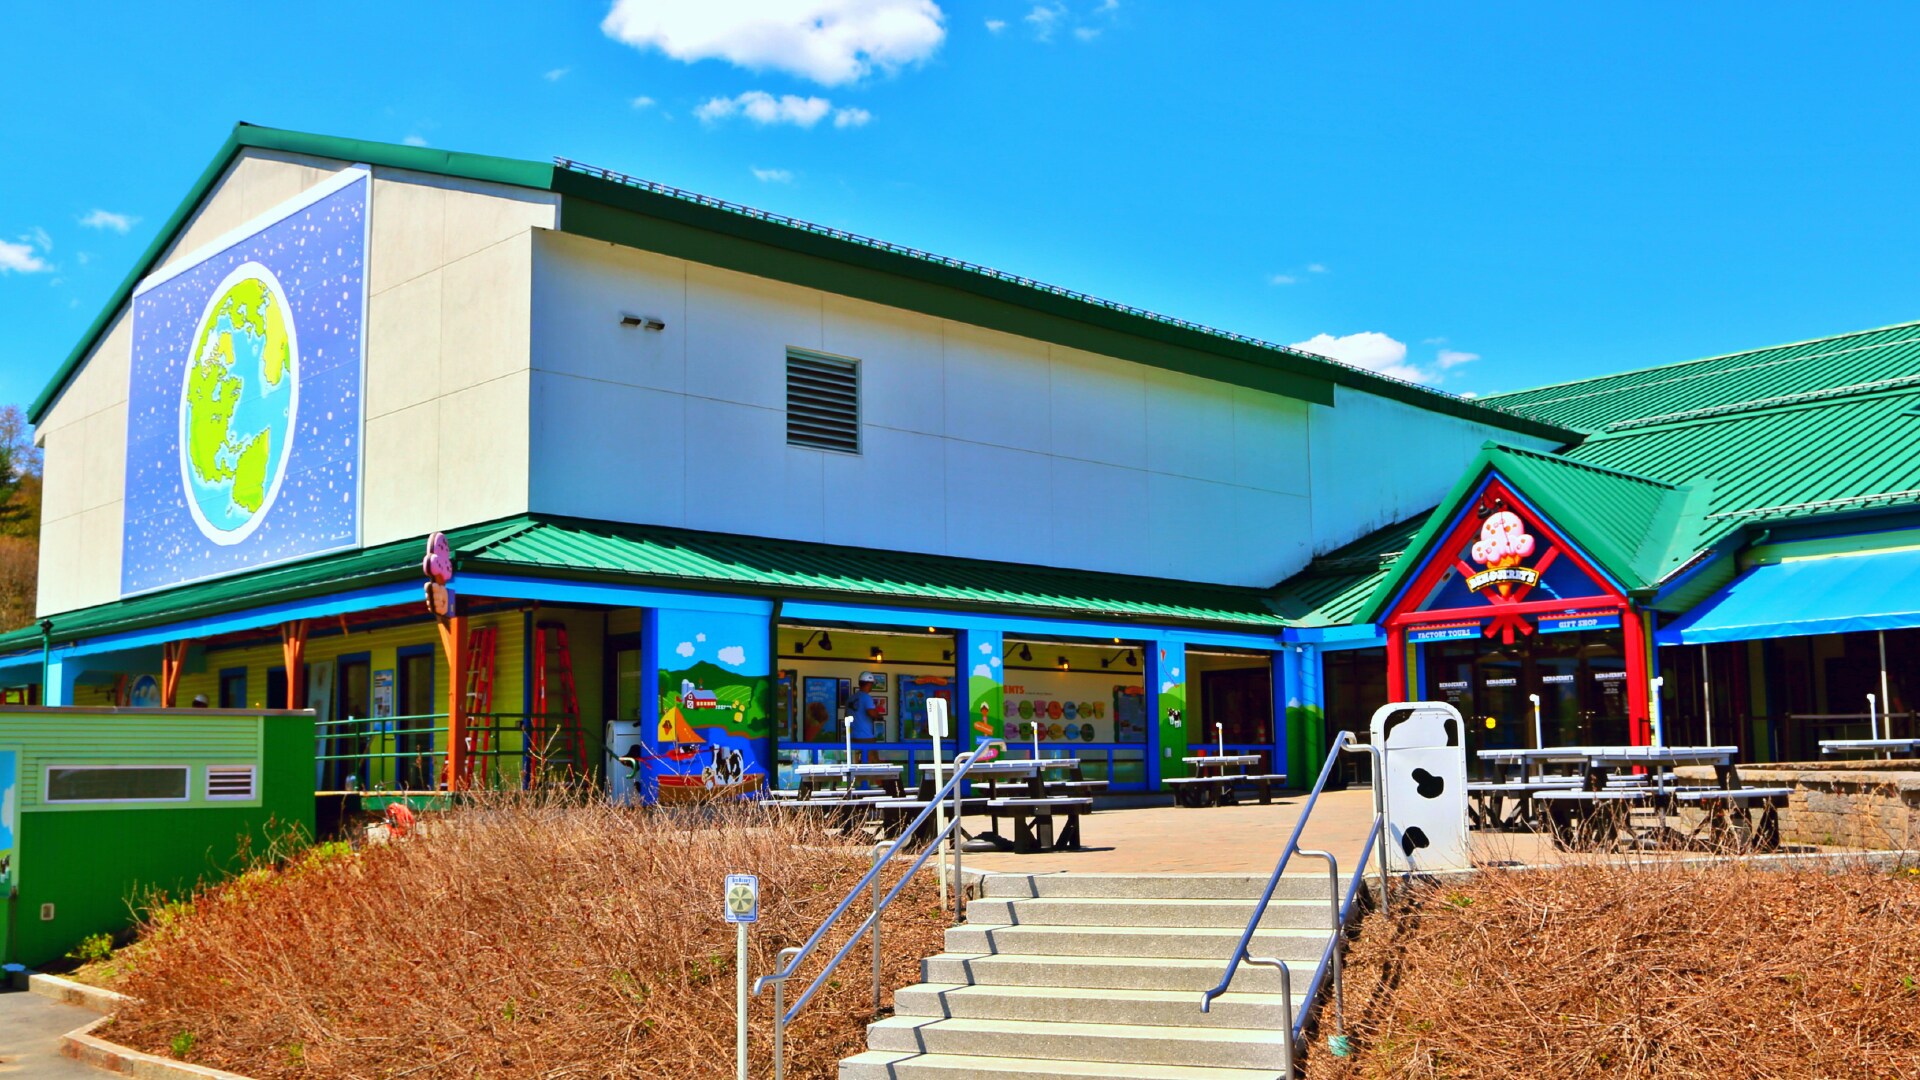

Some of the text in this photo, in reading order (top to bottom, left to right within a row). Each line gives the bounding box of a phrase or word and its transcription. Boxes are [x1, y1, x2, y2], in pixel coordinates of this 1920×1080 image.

[1558, 619, 1598, 629] GIFT SHOP
[1417, 629, 1471, 639] FACTORY TOURS
